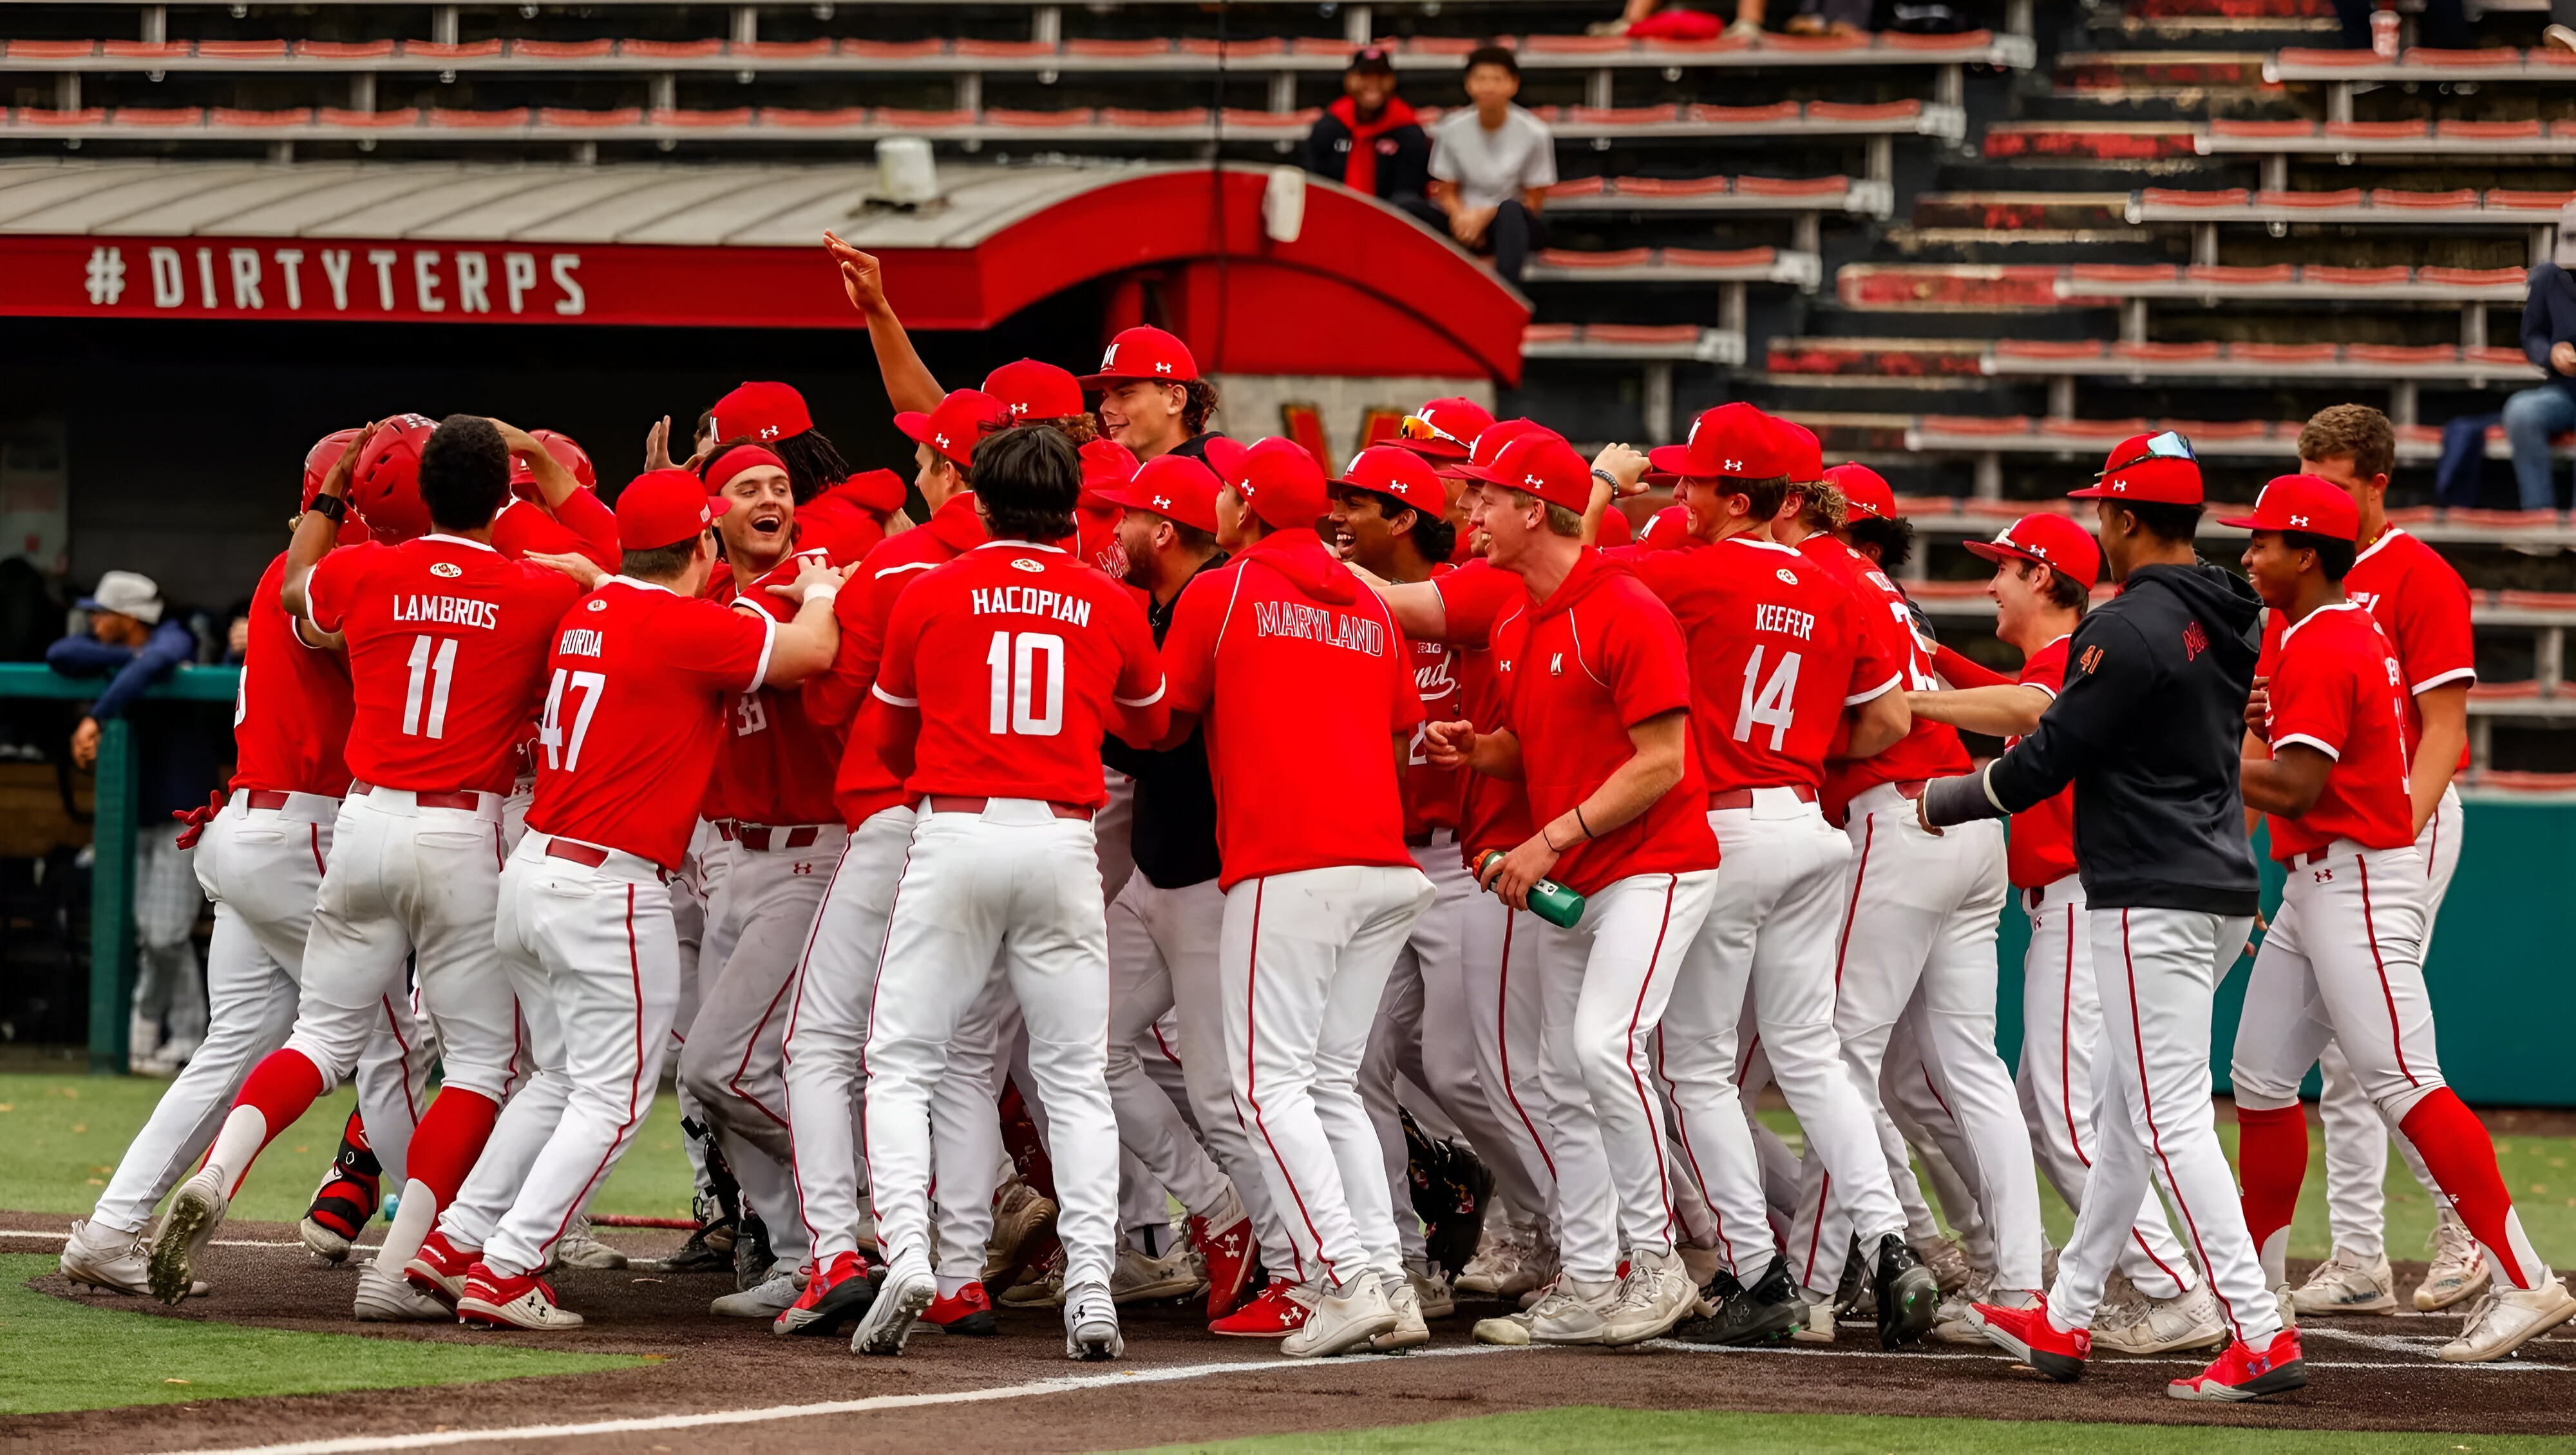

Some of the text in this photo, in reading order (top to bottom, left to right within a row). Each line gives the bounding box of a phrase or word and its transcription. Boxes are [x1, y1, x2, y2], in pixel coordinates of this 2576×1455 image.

[393, 594, 499, 630] LAMBROS
[971, 586, 1091, 627] HACOPIAN
[1255, 601, 1383, 656] MARYLAND
[1756, 604, 1815, 641] KEEFER
[559, 629, 602, 658] HURDA
[2080, 645, 2104, 674] 41
[402, 634, 458, 739] 11
[987, 631, 1064, 736] 10
[1733, 644, 1801, 751] 14
[540, 668, 606, 772] 47
